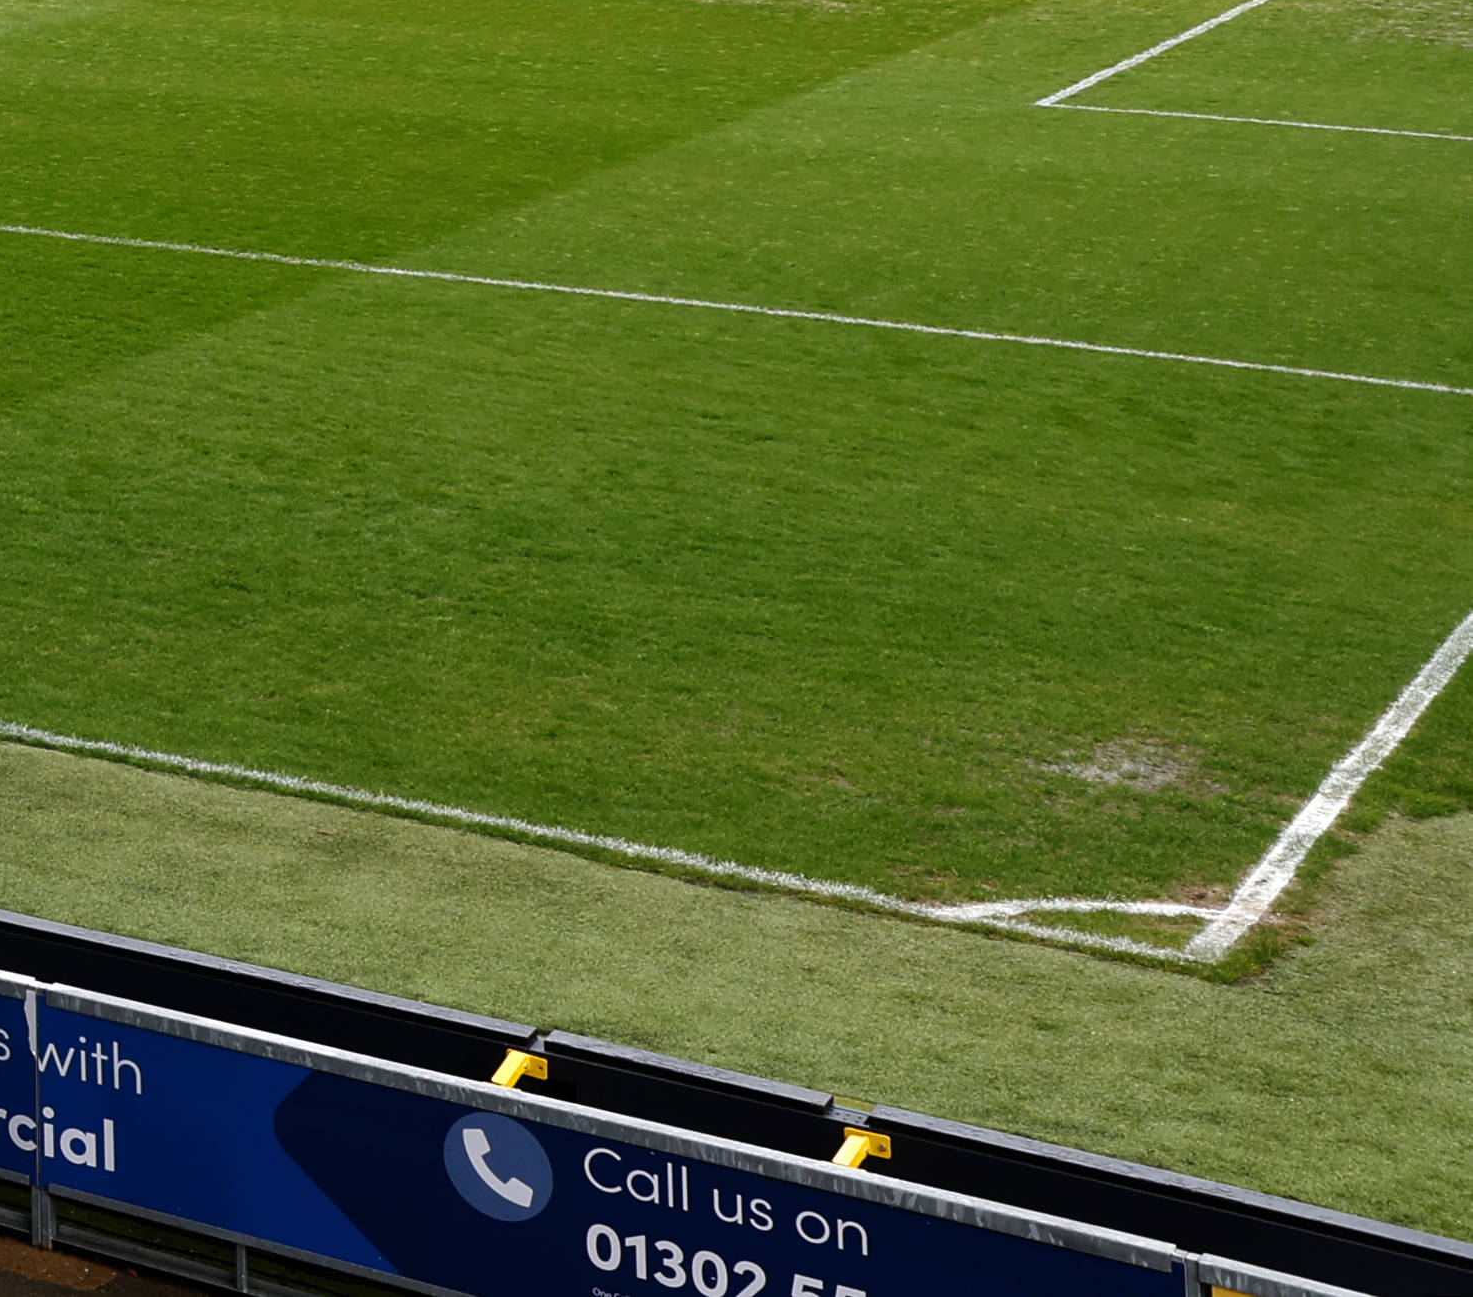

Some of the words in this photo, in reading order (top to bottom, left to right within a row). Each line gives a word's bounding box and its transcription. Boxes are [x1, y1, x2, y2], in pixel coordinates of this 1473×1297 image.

[38, 1036, 143, 1095] with
[584, 1147, 689, 1212] Call
[713, 1189, 775, 1231] us
[795, 1209, 869, 1257] on
[587, 1223, 766, 1297] 01302
